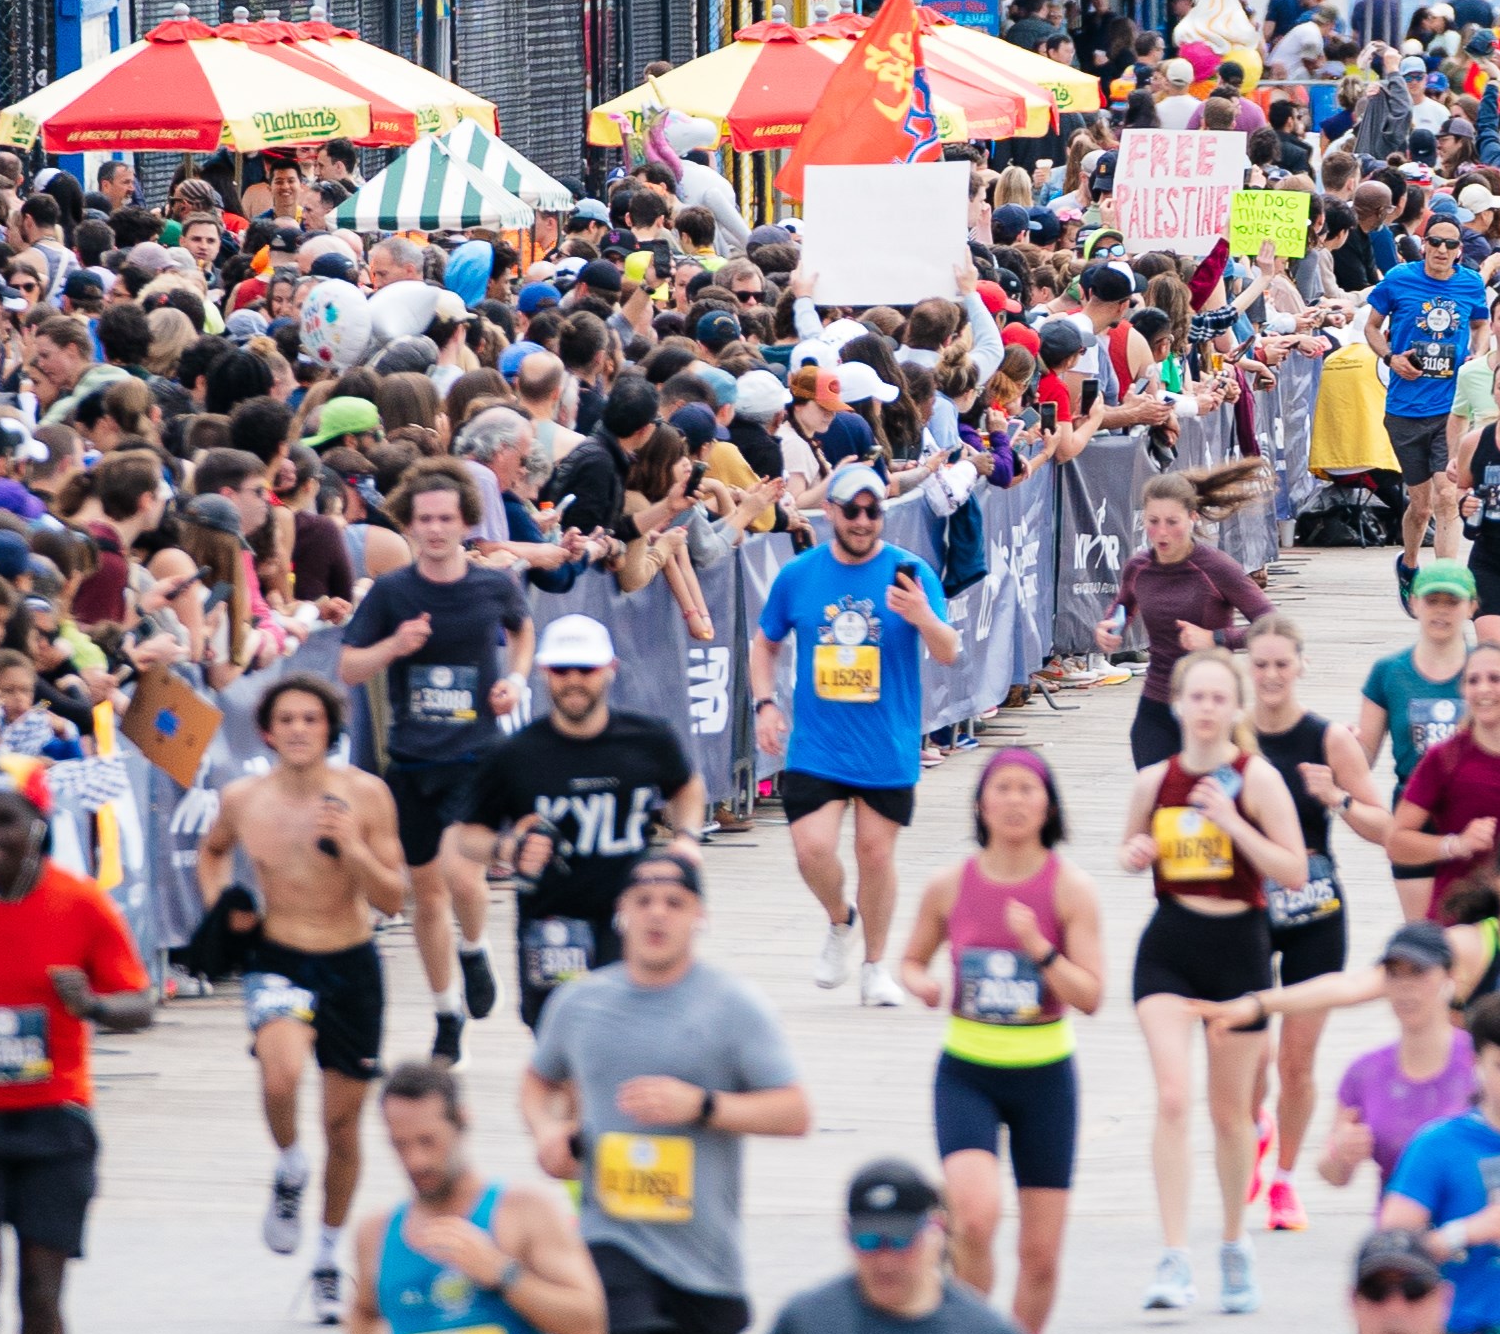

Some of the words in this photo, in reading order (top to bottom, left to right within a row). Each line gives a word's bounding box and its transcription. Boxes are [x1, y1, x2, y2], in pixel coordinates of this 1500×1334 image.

[254, 107, 337, 135] Nathan's
[1125, 134, 1218, 178] FREE
[1236, 193, 1259, 207] MY
[1264, 194, 1299, 209] DOG
[1234, 208, 1295, 223] THINKS
[1233, 224, 1272, 236] YOU'RE
[1276, 226, 1304, 242] COOL
[1422, 356, 1450, 371] 31164
